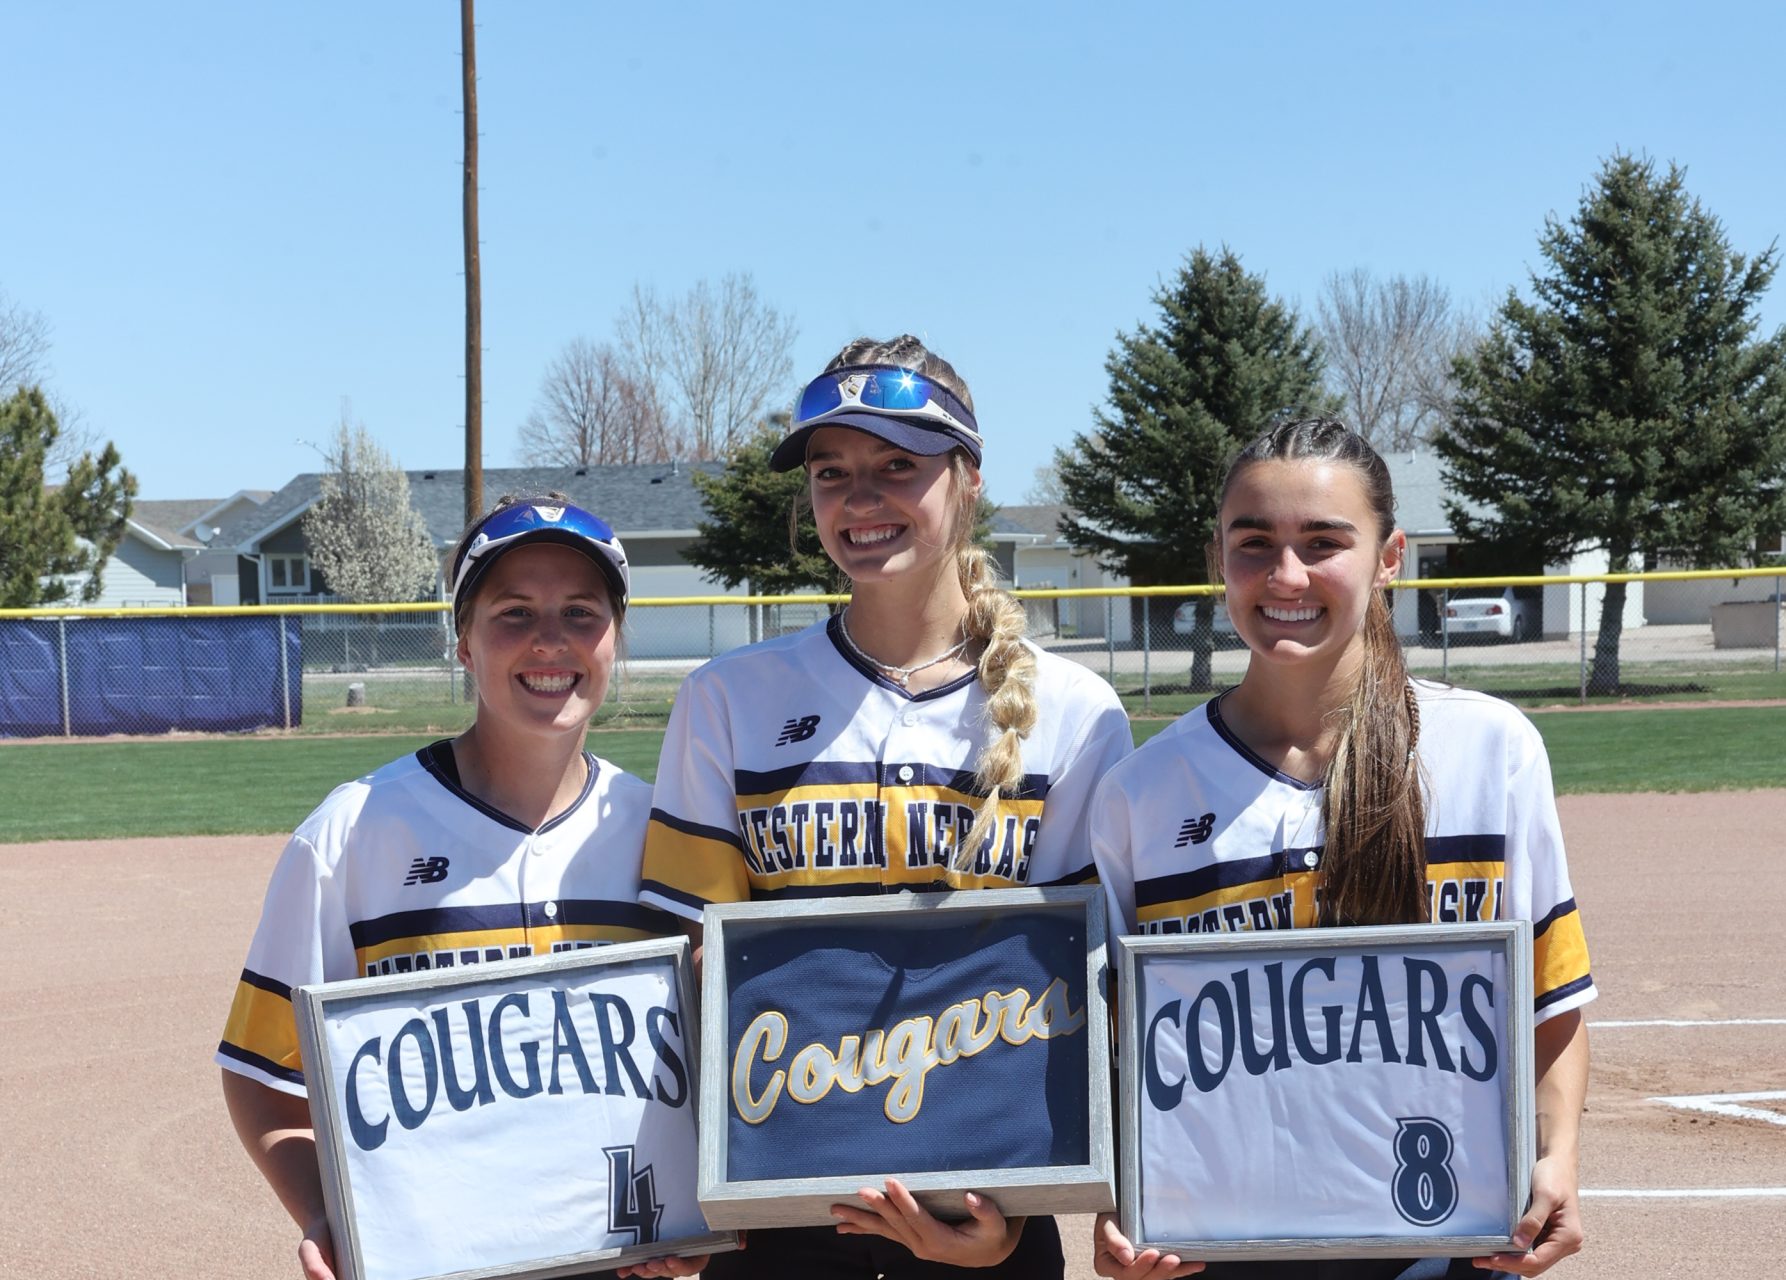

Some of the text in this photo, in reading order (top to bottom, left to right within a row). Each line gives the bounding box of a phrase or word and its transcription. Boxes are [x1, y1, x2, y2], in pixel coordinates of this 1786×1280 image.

[345, 990, 688, 1152] COUGARS
[732, 976, 1086, 1125] Cougars
[1145, 955, 1498, 1112] COUGARS
[601, 1144, 665, 1247] 4
[1391, 1116, 1459, 1228] 8
